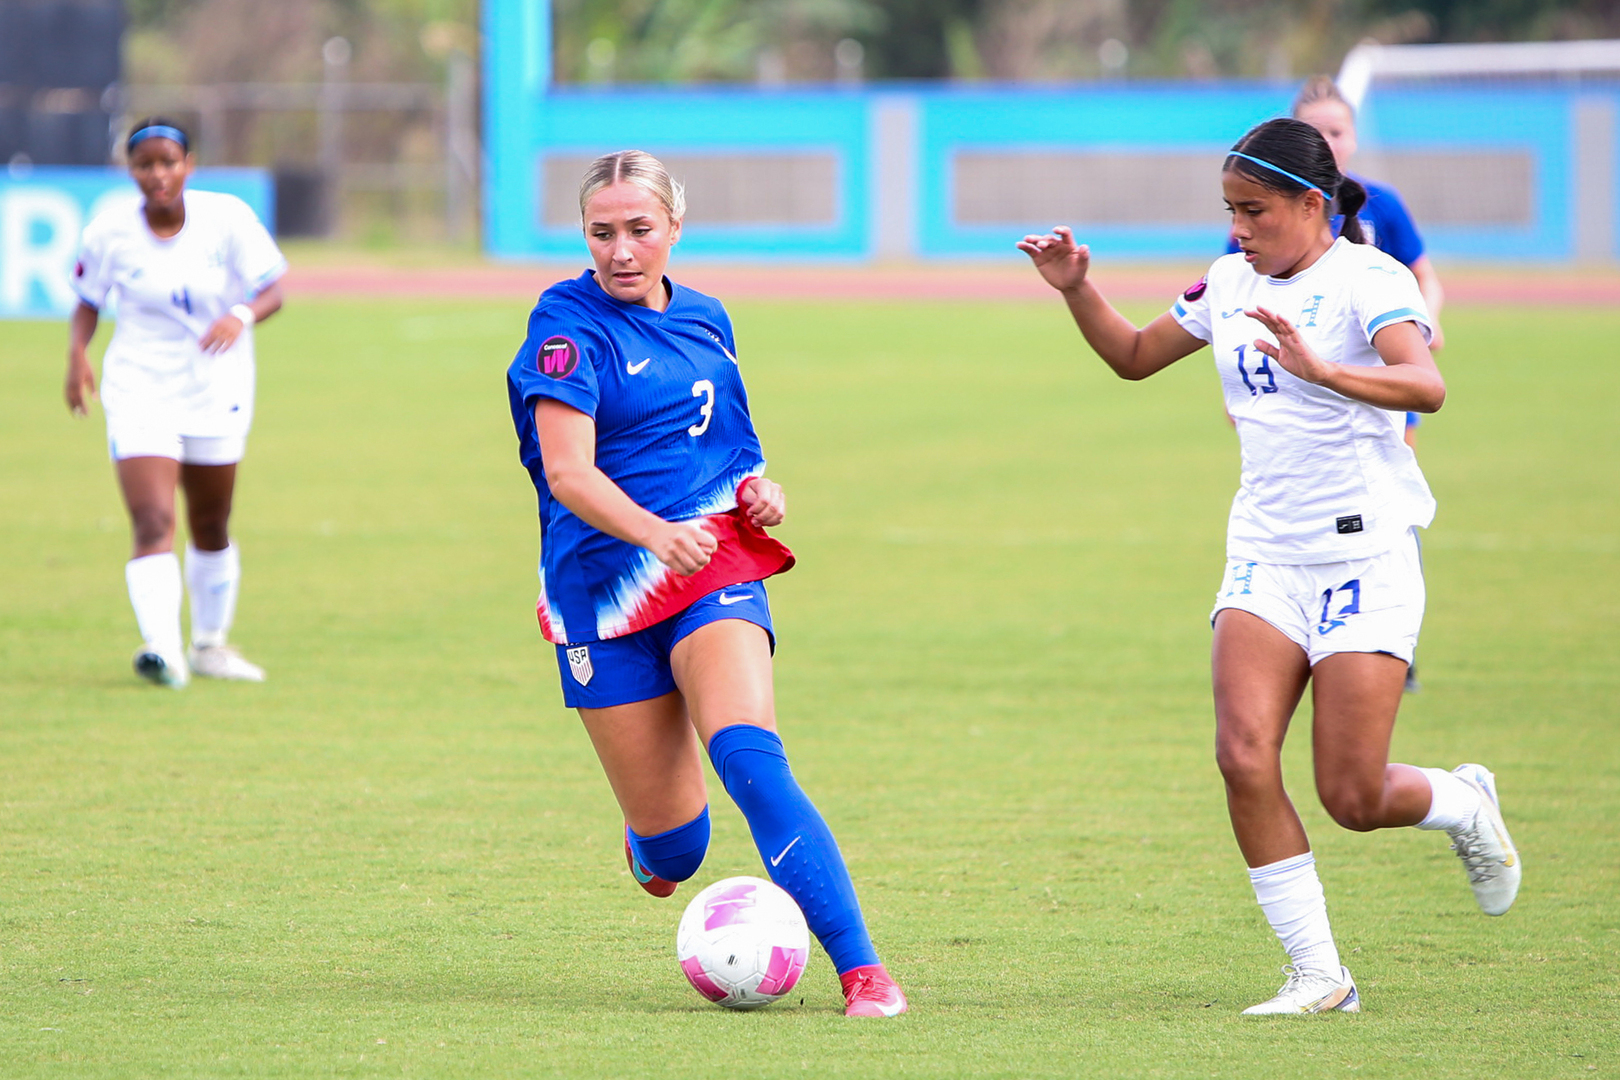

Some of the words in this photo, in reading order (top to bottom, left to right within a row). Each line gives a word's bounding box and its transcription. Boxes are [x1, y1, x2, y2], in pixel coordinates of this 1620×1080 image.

[170, 286, 193, 315] 4
[1233, 344, 1279, 396] 13
[688, 379, 714, 437] 3
[567, 648, 587, 665] USA
